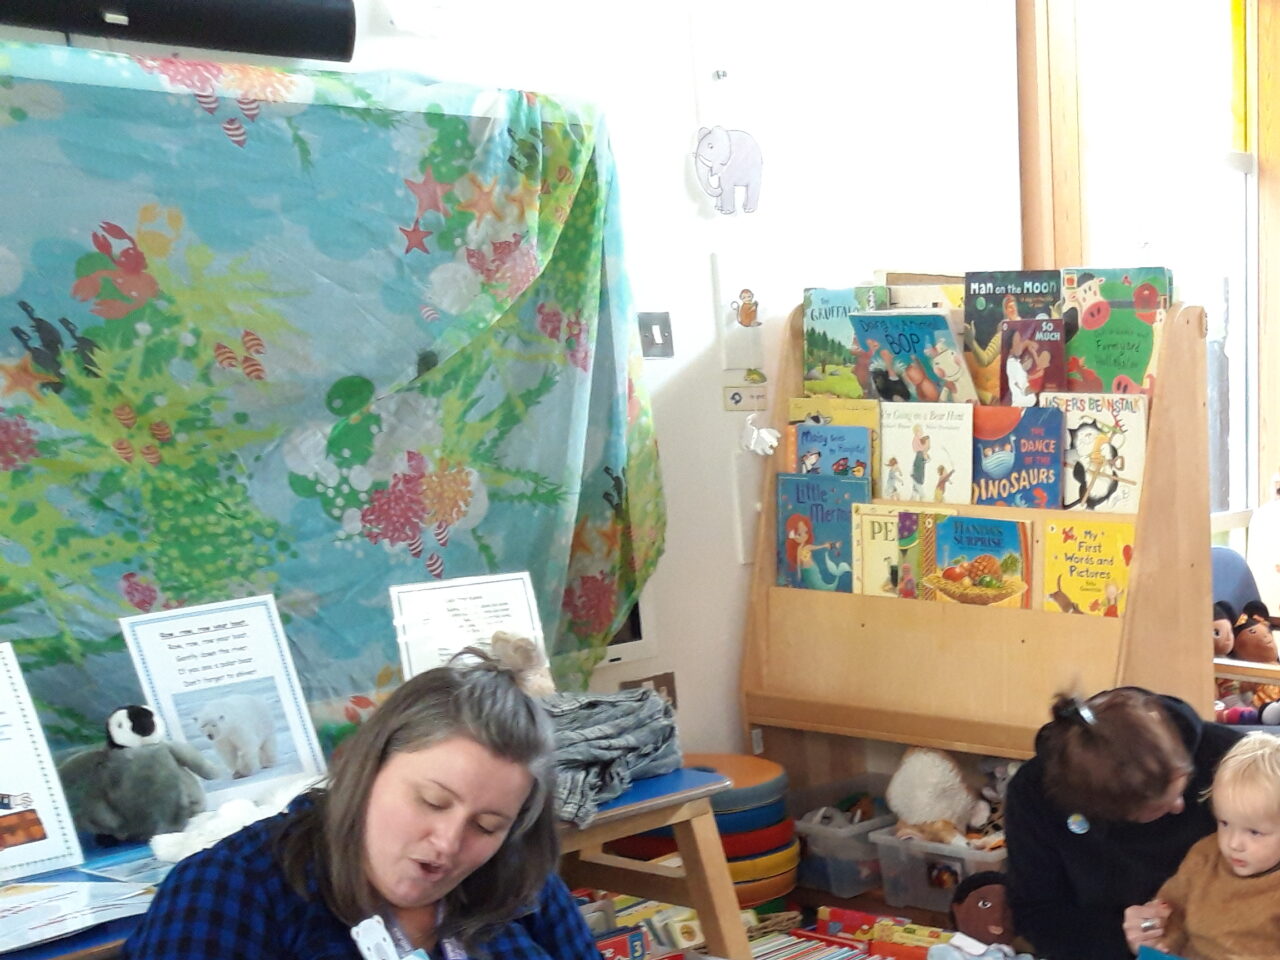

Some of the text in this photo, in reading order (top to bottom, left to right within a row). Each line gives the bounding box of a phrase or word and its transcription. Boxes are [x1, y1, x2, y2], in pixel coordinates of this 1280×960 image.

[970, 281, 1057, 295] Man on the Moon
[1041, 321, 1054, 332] SO
[1034, 331, 1061, 341] MUCH
[885, 333, 921, 355] BOP
[1020, 438, 1056, 453] DANCE
[796, 482, 828, 504] Little
[869, 520, 896, 542] PE
[1084, 530, 1098, 541] My
[1078, 541, 1102, 553] First
[1064, 552, 1114, 566] Words and
[1069, 565, 1111, 579] Pictures
